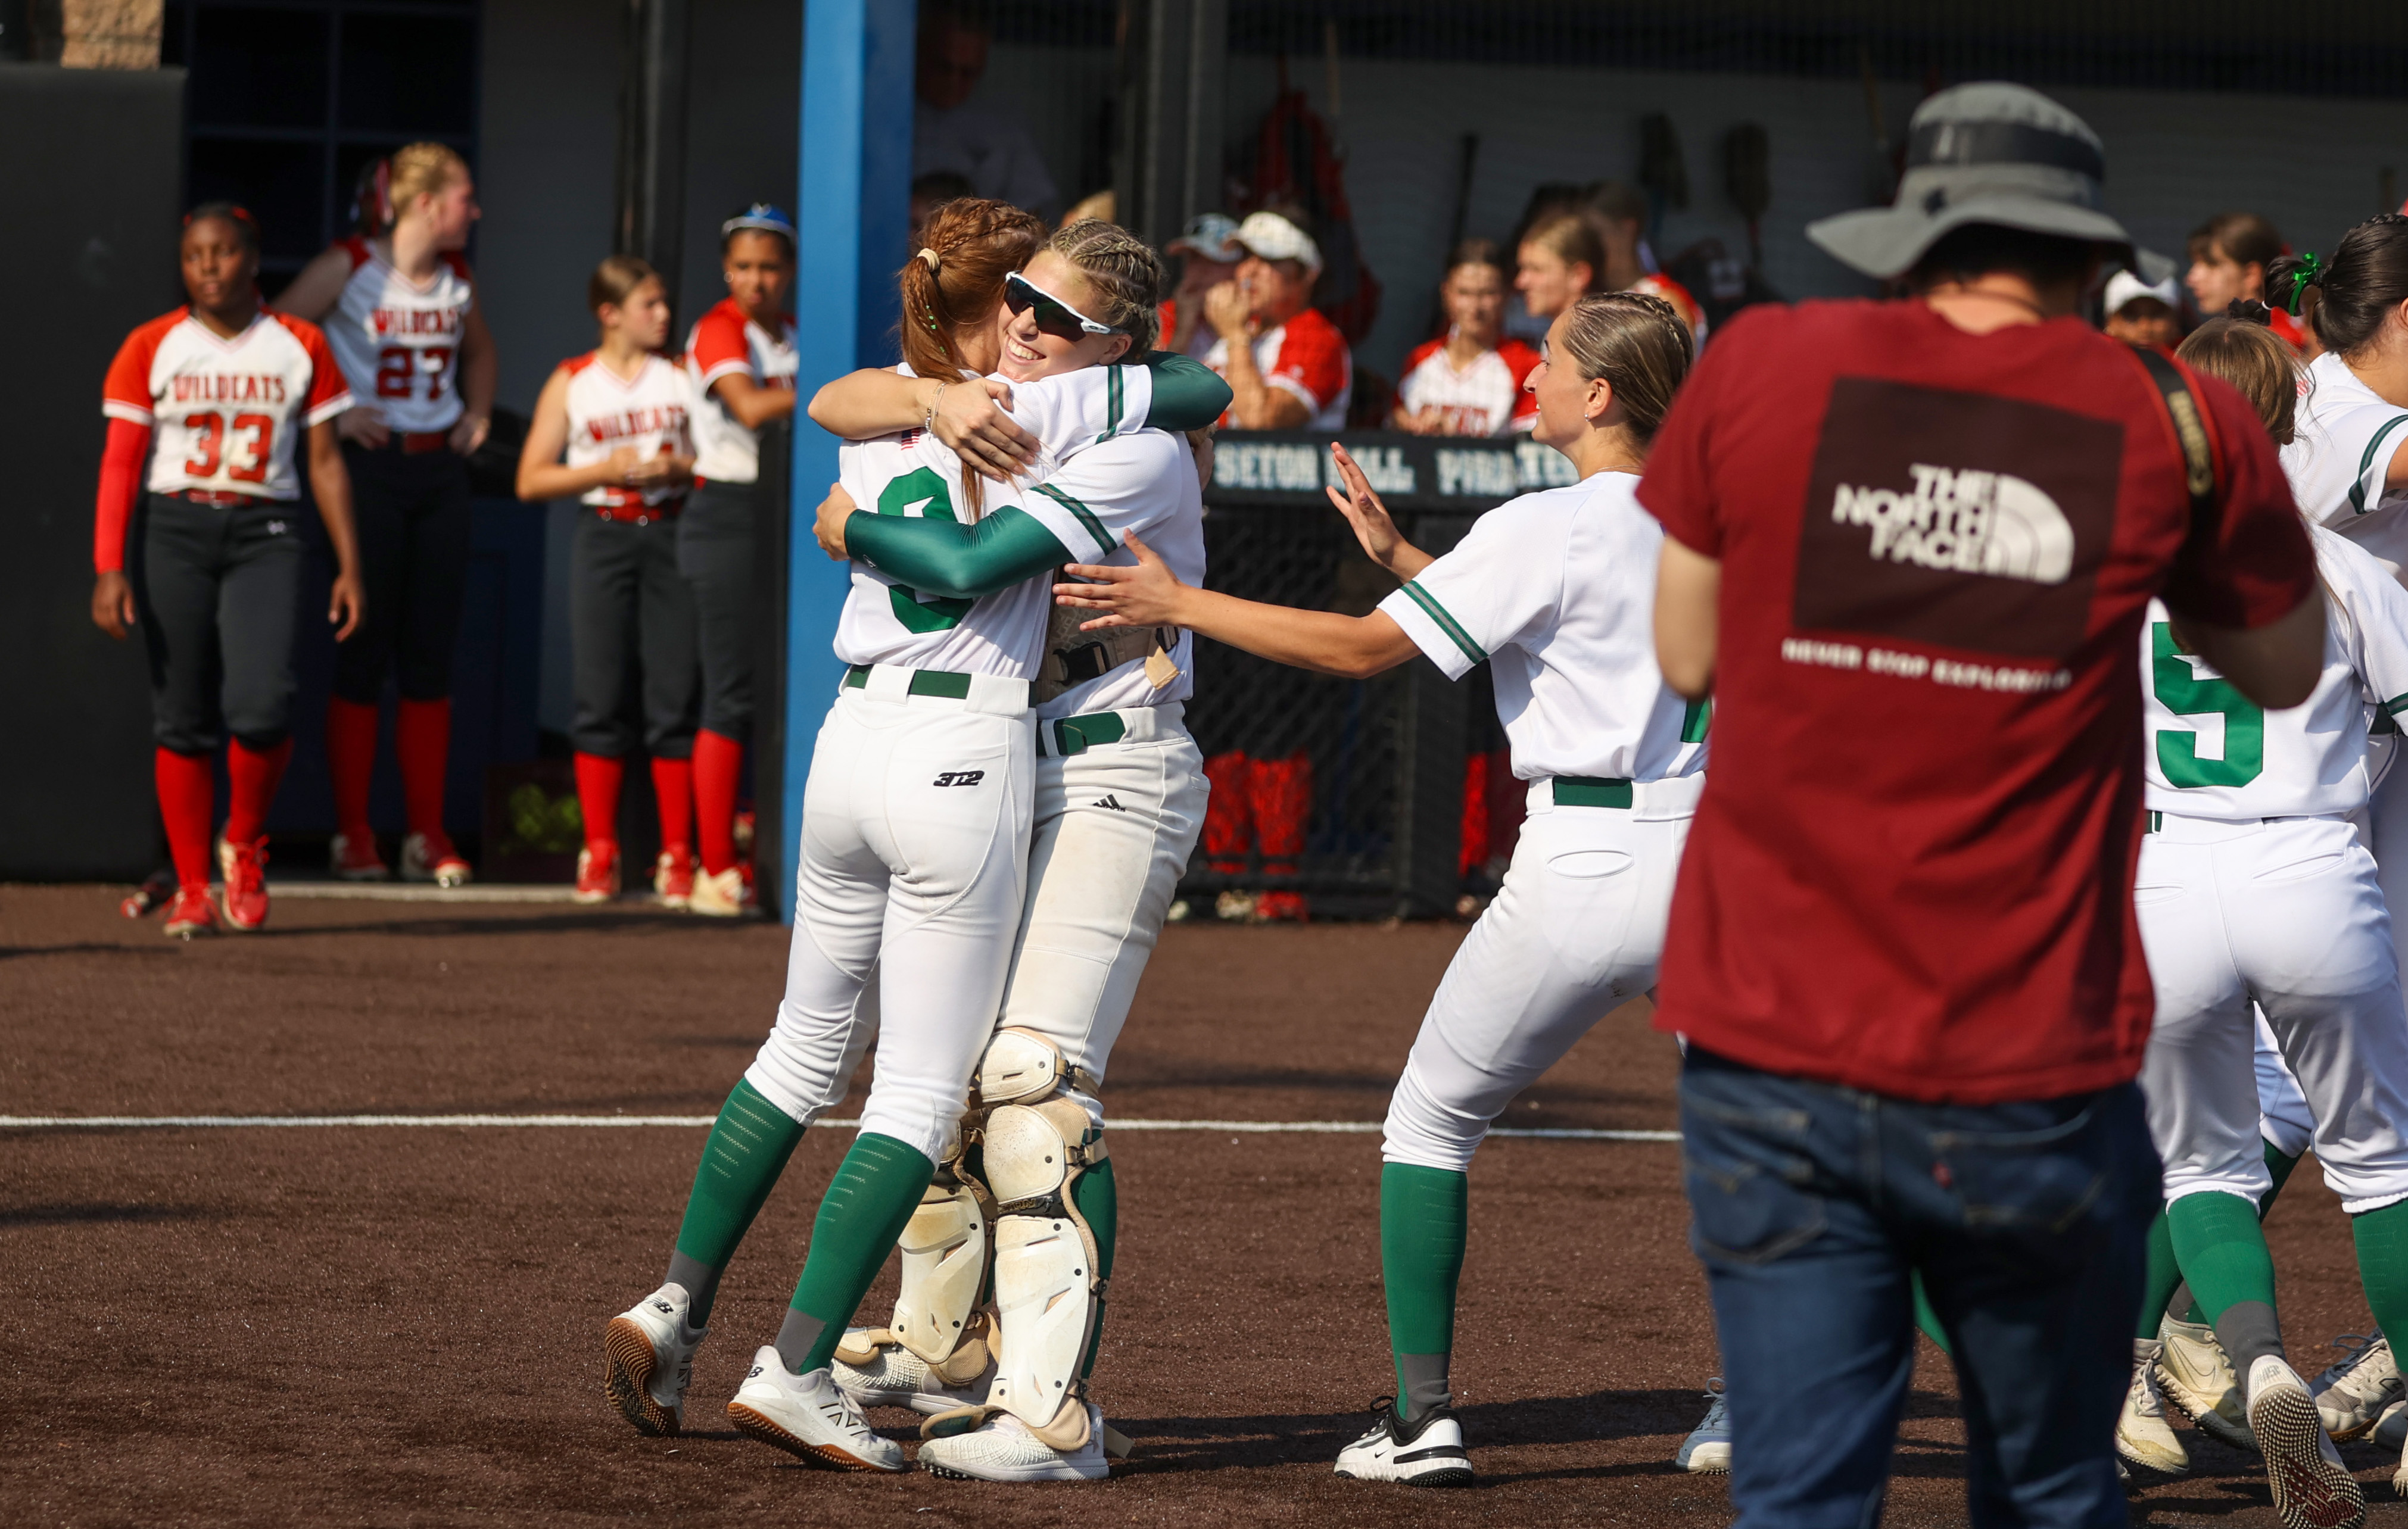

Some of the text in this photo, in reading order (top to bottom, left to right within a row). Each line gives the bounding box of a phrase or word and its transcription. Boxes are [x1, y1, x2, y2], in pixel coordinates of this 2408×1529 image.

[173, 373, 286, 404] WILDCATS
[376, 347, 453, 401] 27
[185, 411, 274, 483] 33
[1213, 441, 1320, 493] SETON
[1435, 442, 1581, 497] PIRATE
[1831, 482, 1992, 538] NORTH
[1908, 462, 1996, 504] THE
[1869, 523, 1986, 573] FACE
[1781, 636, 1864, 670] NEVER
[1865, 647, 1930, 679] STOP
[2151, 621, 2264, 788] 5
